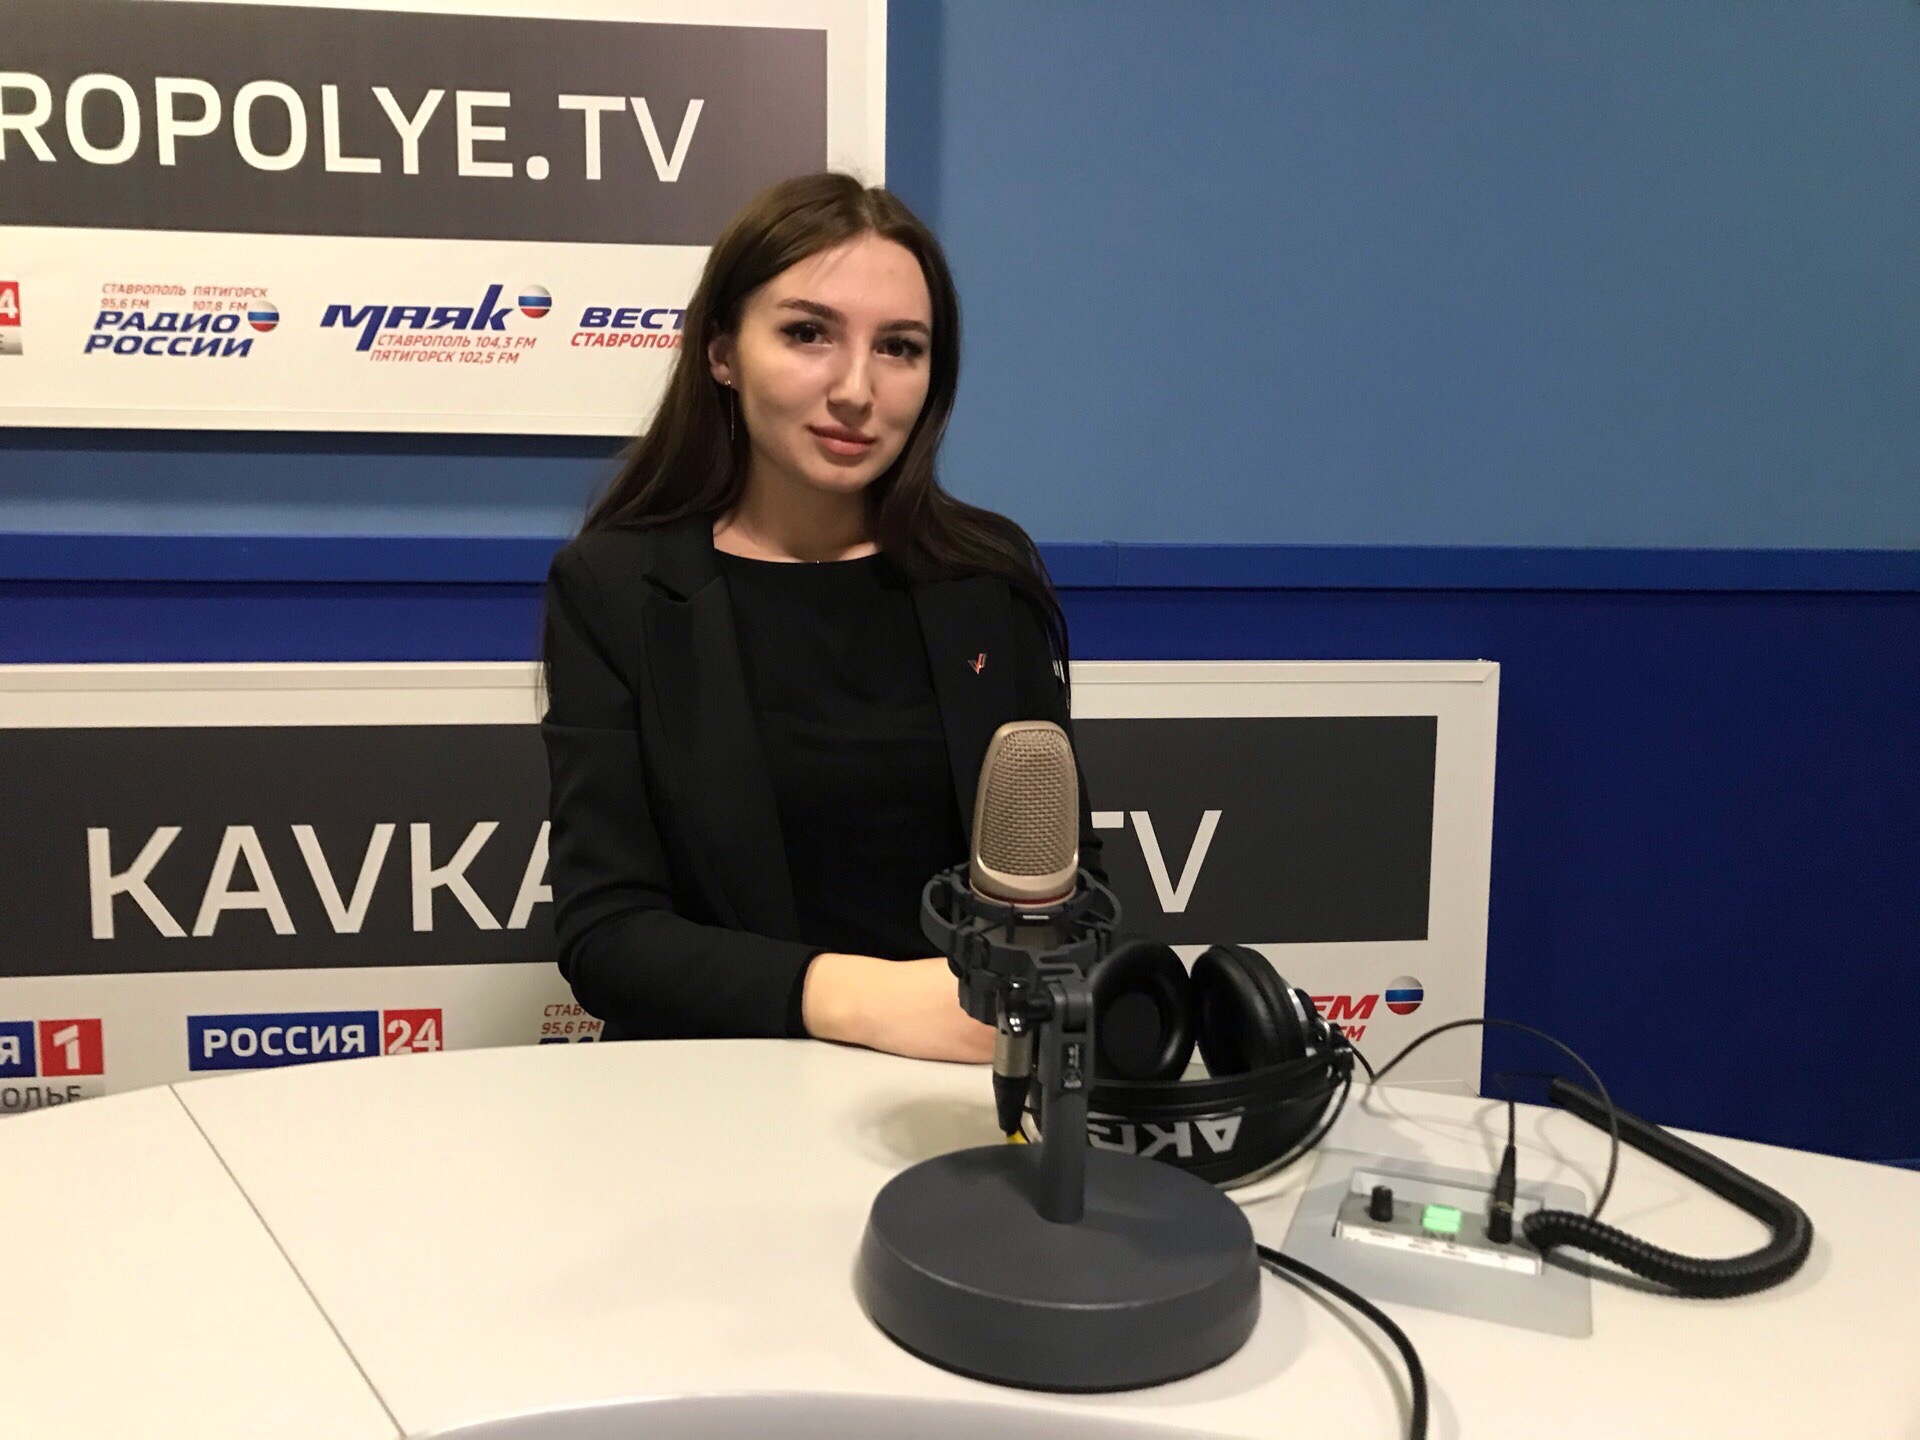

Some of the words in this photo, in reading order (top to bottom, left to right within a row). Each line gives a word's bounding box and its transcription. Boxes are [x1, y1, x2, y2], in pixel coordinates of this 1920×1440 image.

[0, 71, 704, 184] ROPOLYE.TV
[102, 283, 187, 296] СТАВРОПОЛЬ
[193, 285, 269, 299] ПЯТИГОРСК
[101, 298, 128, 310] 95,6
[131, 300, 150, 310] FM
[193, 301, 223, 312] 107,8
[229, 302, 248, 312] FM
[94, 310, 240, 334] РАДИО
[83, 334, 254, 358] РОССИИ
[377, 334, 470, 348] СТАВРОПОЛЬ
[475, 336, 511, 350] 104,3
[515, 338, 536, 349] FM
[370, 350, 455, 364] ПЯТИГОРСК
[459, 352, 495, 365] 102,5
[498, 353, 519, 364] FM
[1091, 809, 1223, 914] V
[543, 1004, 587, 1017] СТАВ
[541, 1021, 574, 1036] 95,6
[578, 1021, 601, 1033] FM
[1340, 1025, 1367, 1042] M
[203, 1024, 366, 1058] РОССИЯ
[386, 1018, 441, 1055] 24
[52, 1024, 81, 1070] 1
